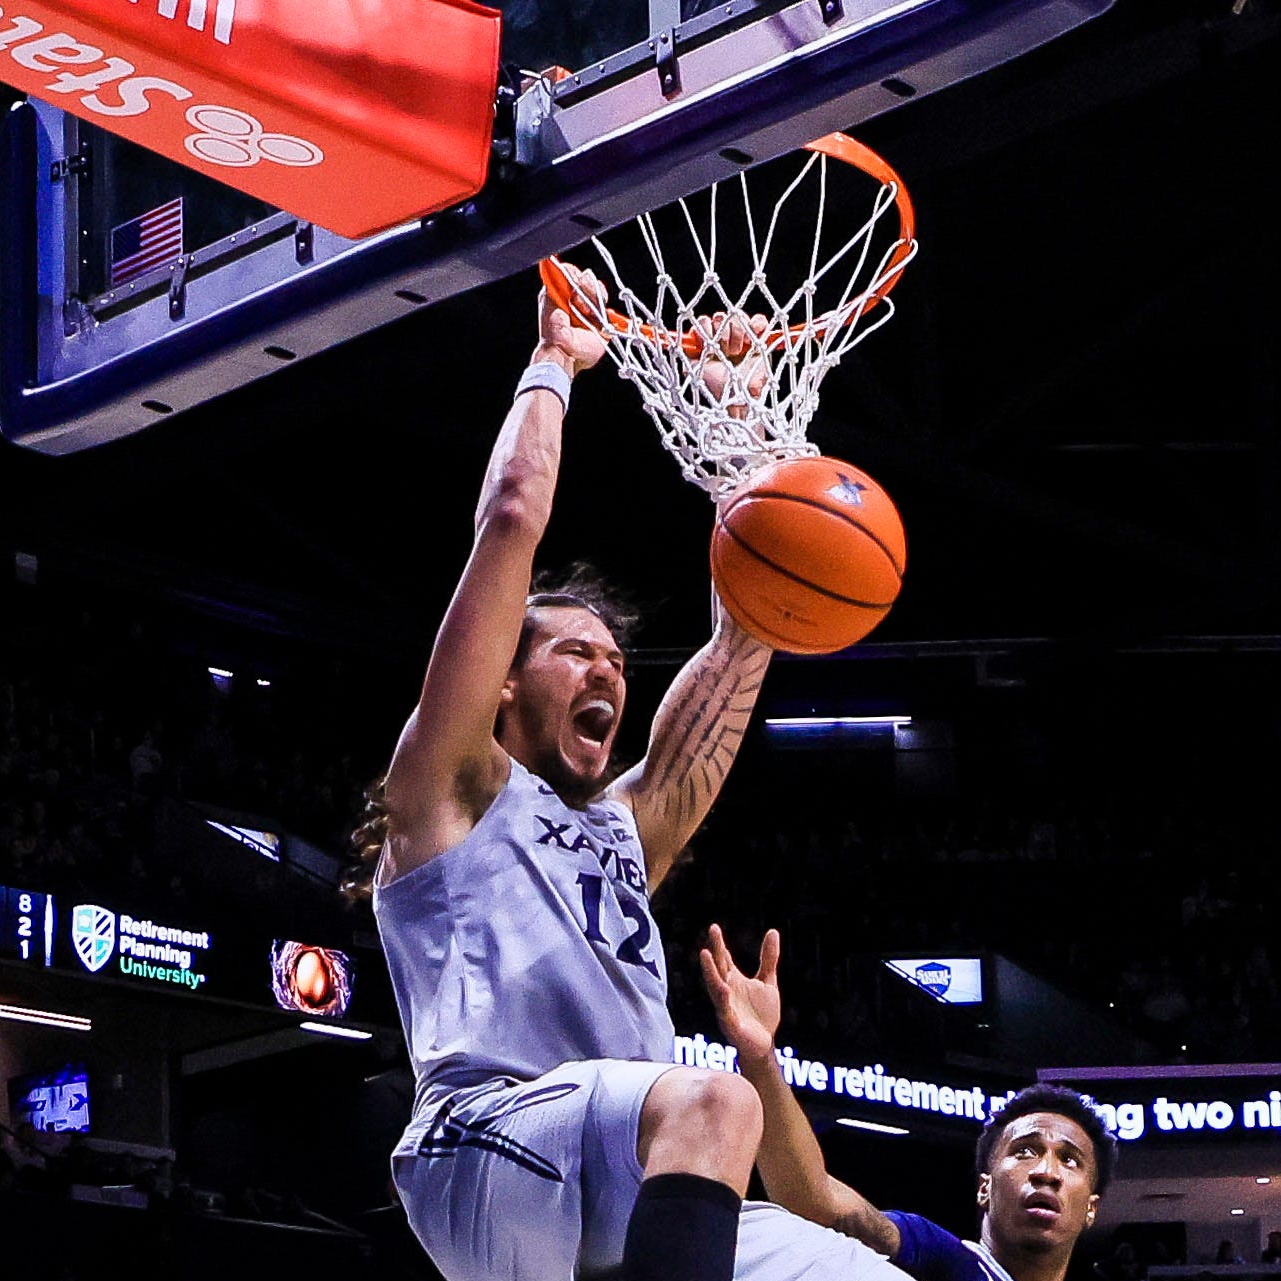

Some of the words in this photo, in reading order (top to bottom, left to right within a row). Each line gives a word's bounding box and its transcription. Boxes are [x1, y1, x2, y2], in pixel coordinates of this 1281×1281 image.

[534, 815, 648, 899] XAVIE
[18, 894, 32, 913] 8
[18, 916, 32, 937] 2
[120, 914, 209, 949] Retirement
[576, 872, 661, 981] 12
[19, 940, 30, 959] 1
[120, 935, 191, 968] Planning
[120, 957, 201, 989] University
[833, 1063, 986, 1120] retirement
[1155, 1096, 1232, 1131] two
